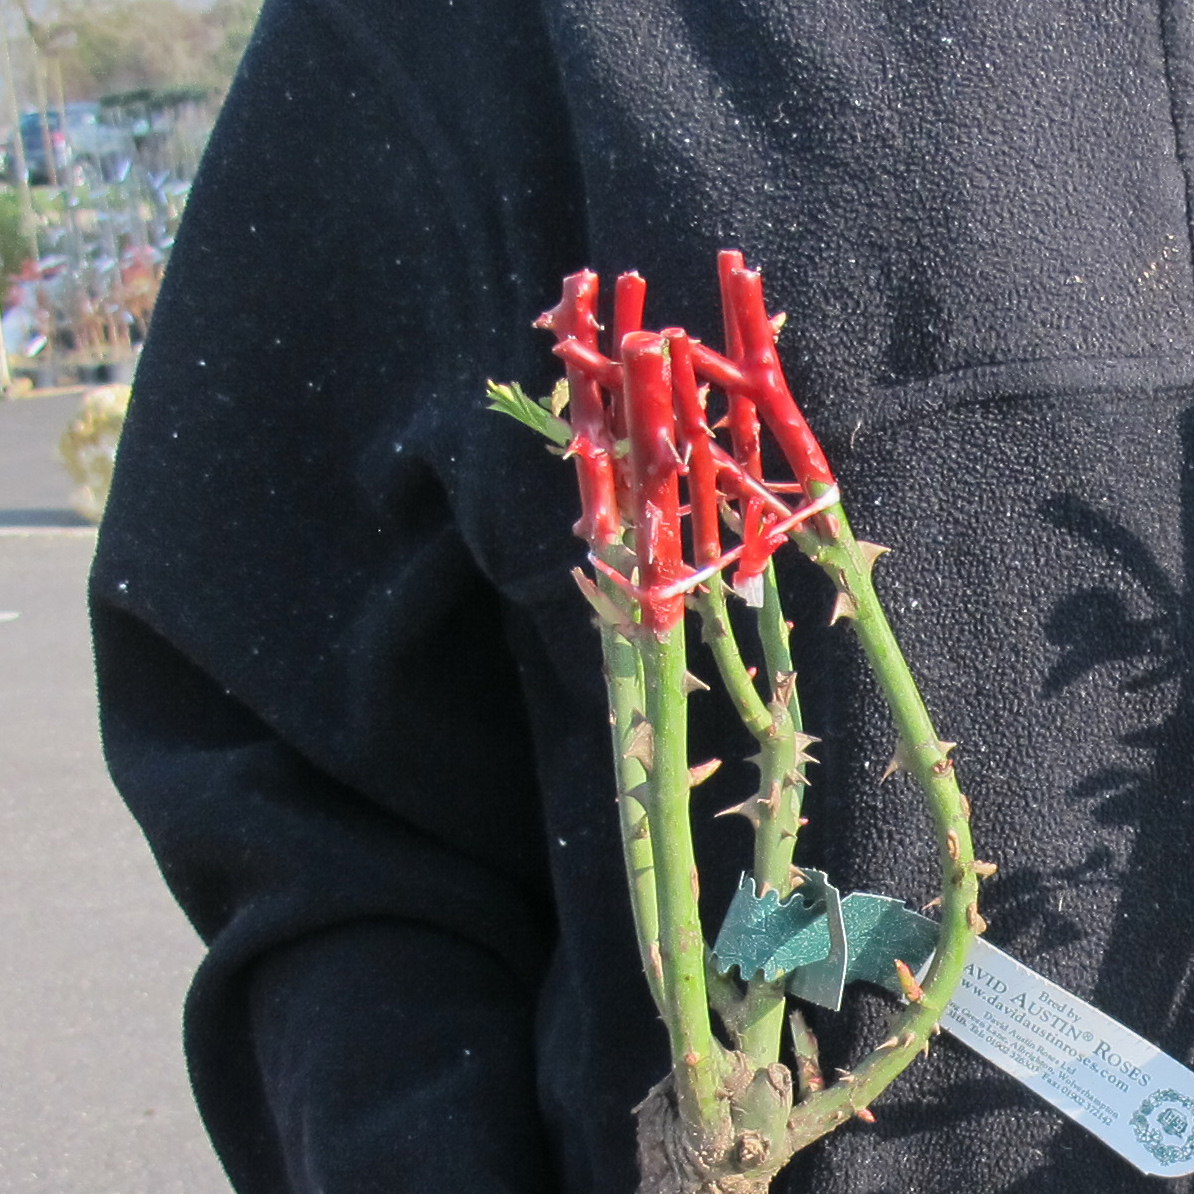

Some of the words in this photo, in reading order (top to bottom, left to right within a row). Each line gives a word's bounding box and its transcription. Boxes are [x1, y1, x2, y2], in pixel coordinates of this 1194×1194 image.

[961, 978, 1130, 1093] ww.davidaustinroses.com
[964, 963, 1007, 994] AVID
[1093, 1040, 1151, 1086] ROSES
[984, 1012, 1007, 1031] David
[1009, 1031, 1034, 1049] Austin
[1039, 992, 1067, 1013] Bred
[1067, 1009, 1081, 1023] by
